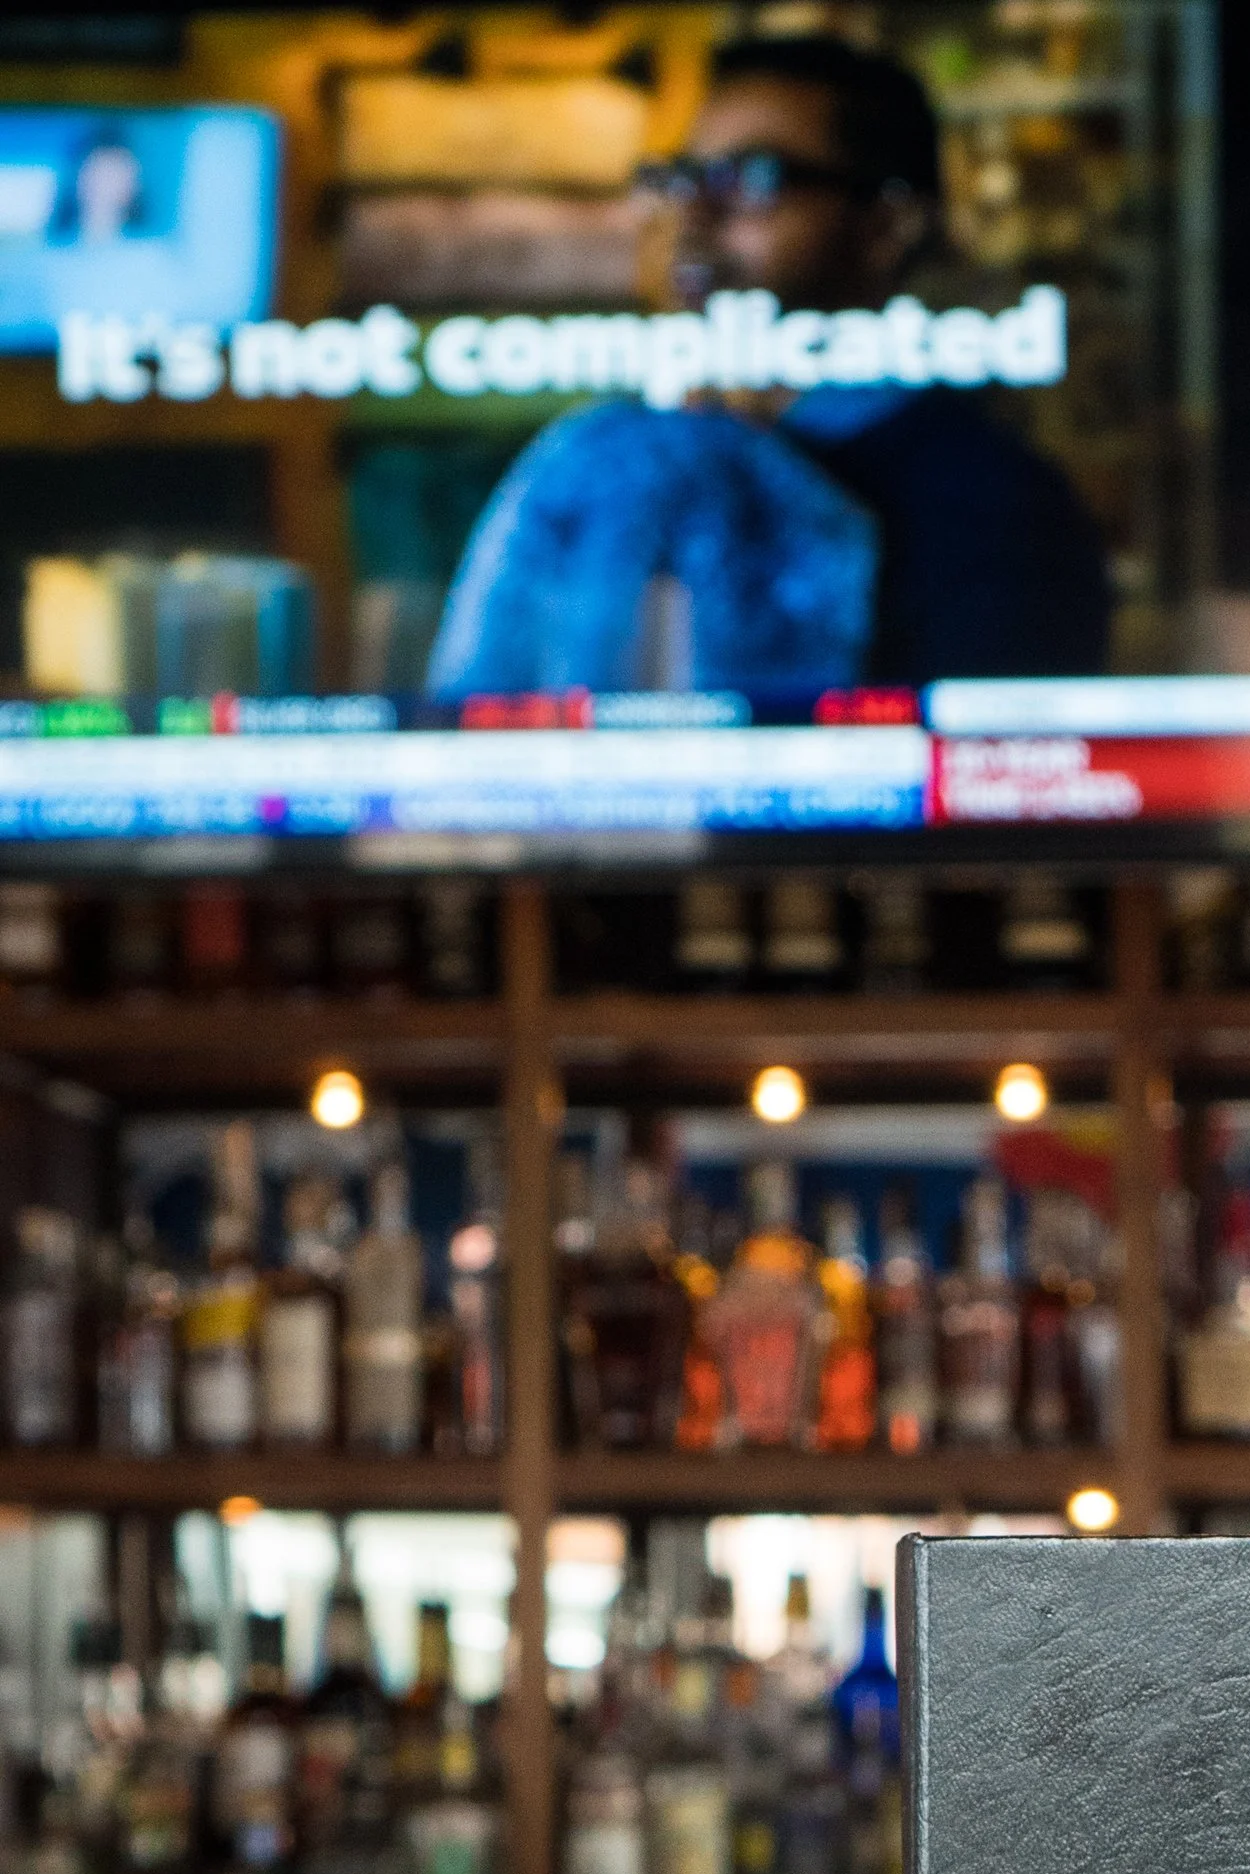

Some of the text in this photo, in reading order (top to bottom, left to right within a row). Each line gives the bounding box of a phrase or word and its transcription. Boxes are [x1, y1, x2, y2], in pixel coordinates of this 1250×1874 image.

[59, 285, 1068, 411] It's not complicated
